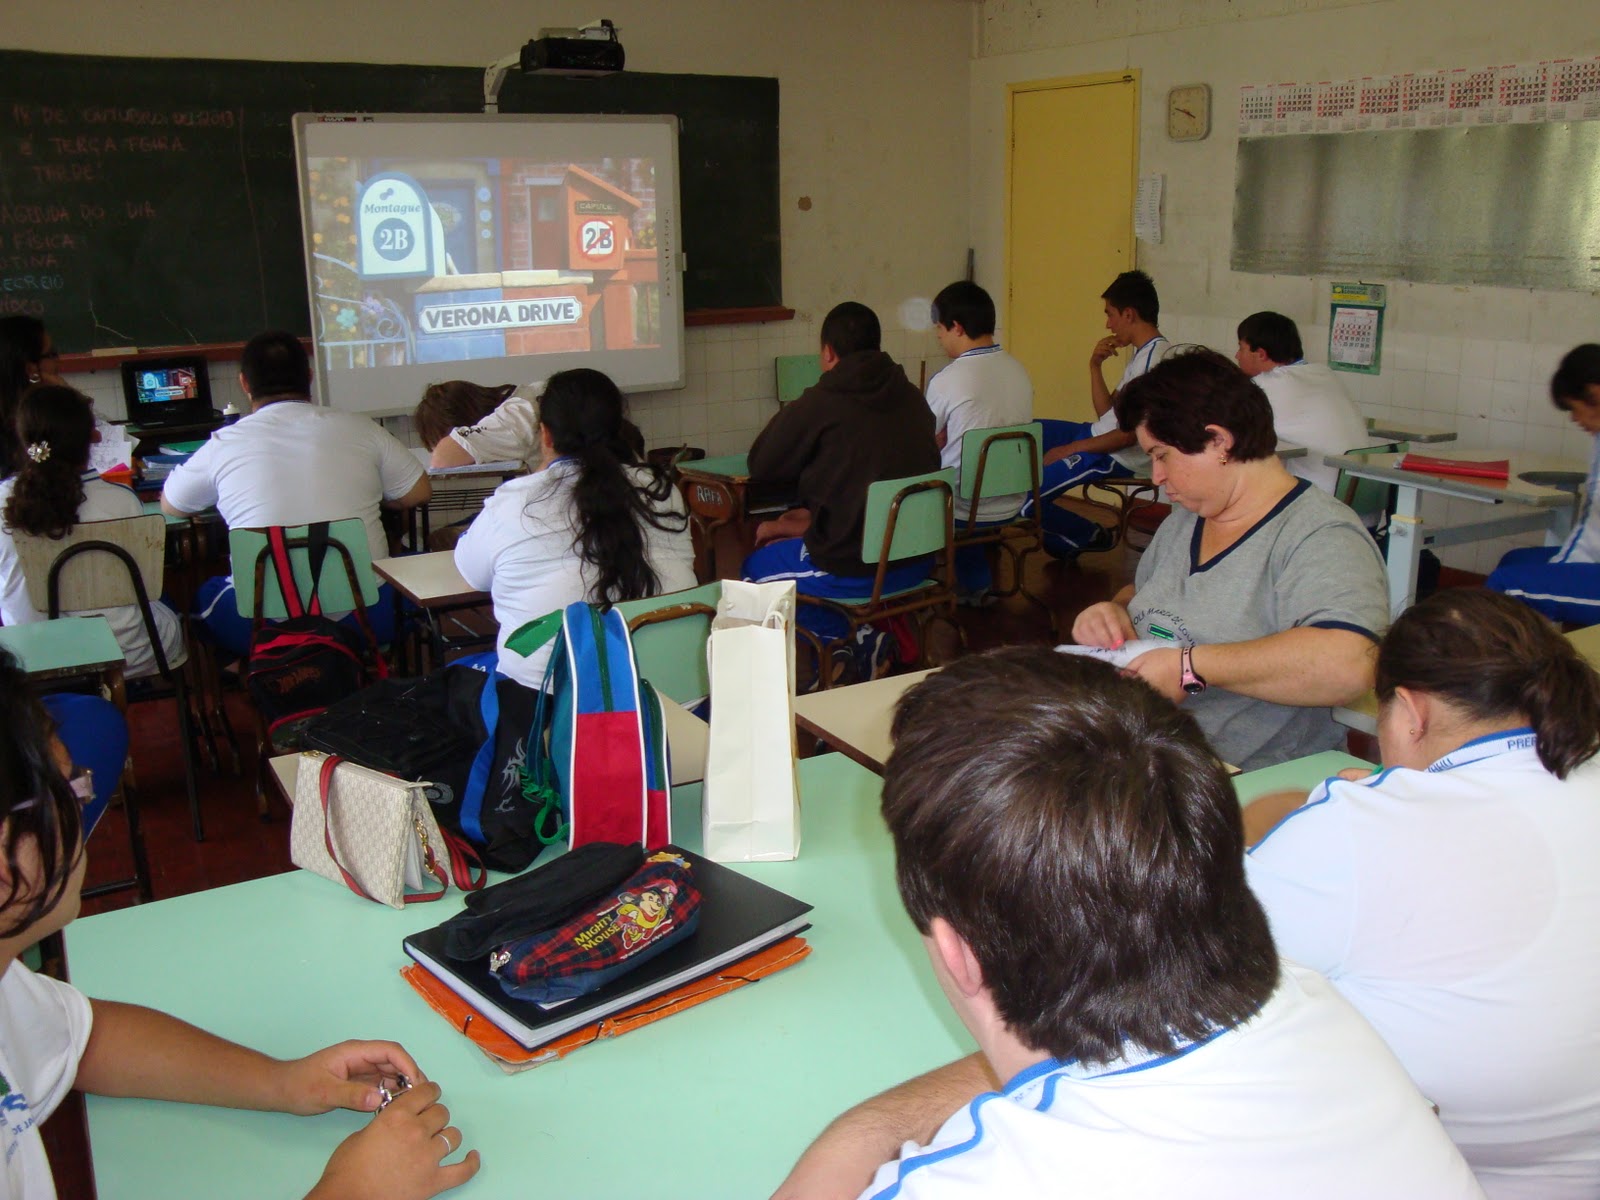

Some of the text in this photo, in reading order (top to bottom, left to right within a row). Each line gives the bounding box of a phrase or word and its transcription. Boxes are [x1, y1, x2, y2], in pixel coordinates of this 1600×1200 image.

[364, 204, 421, 215] Montague
[380, 228, 409, 250] 2B
[425, 302, 575, 329] VERONA DRIVE
[574, 914, 614, 946] MIGHTY
[581, 923, 621, 951] MOUSE
